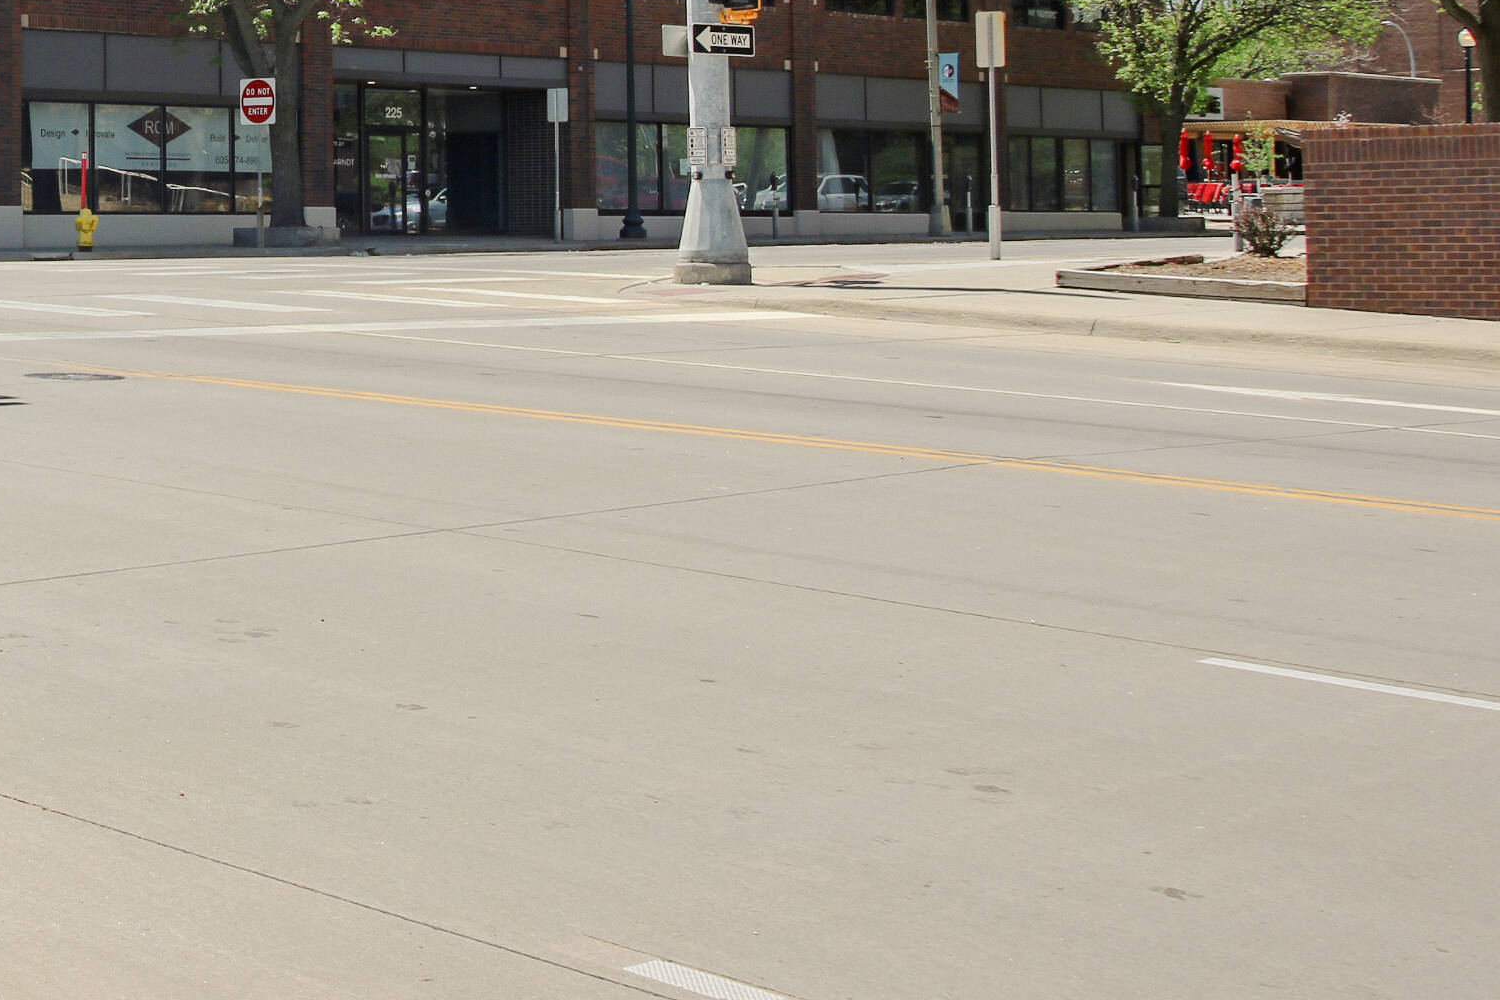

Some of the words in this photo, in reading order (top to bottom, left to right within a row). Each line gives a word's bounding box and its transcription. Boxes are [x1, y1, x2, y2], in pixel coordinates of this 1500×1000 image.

[711, 33, 728, 46] ONE
[730, 34, 748, 47] WAY
[245, 88, 255, 96] DO
[257, 87, 270, 96] NOT
[248, 107, 268, 115] ENTER
[385, 106, 403, 119] 225
[40, 128, 66, 140] Design
[333, 158, 355, 167] ARNDT
